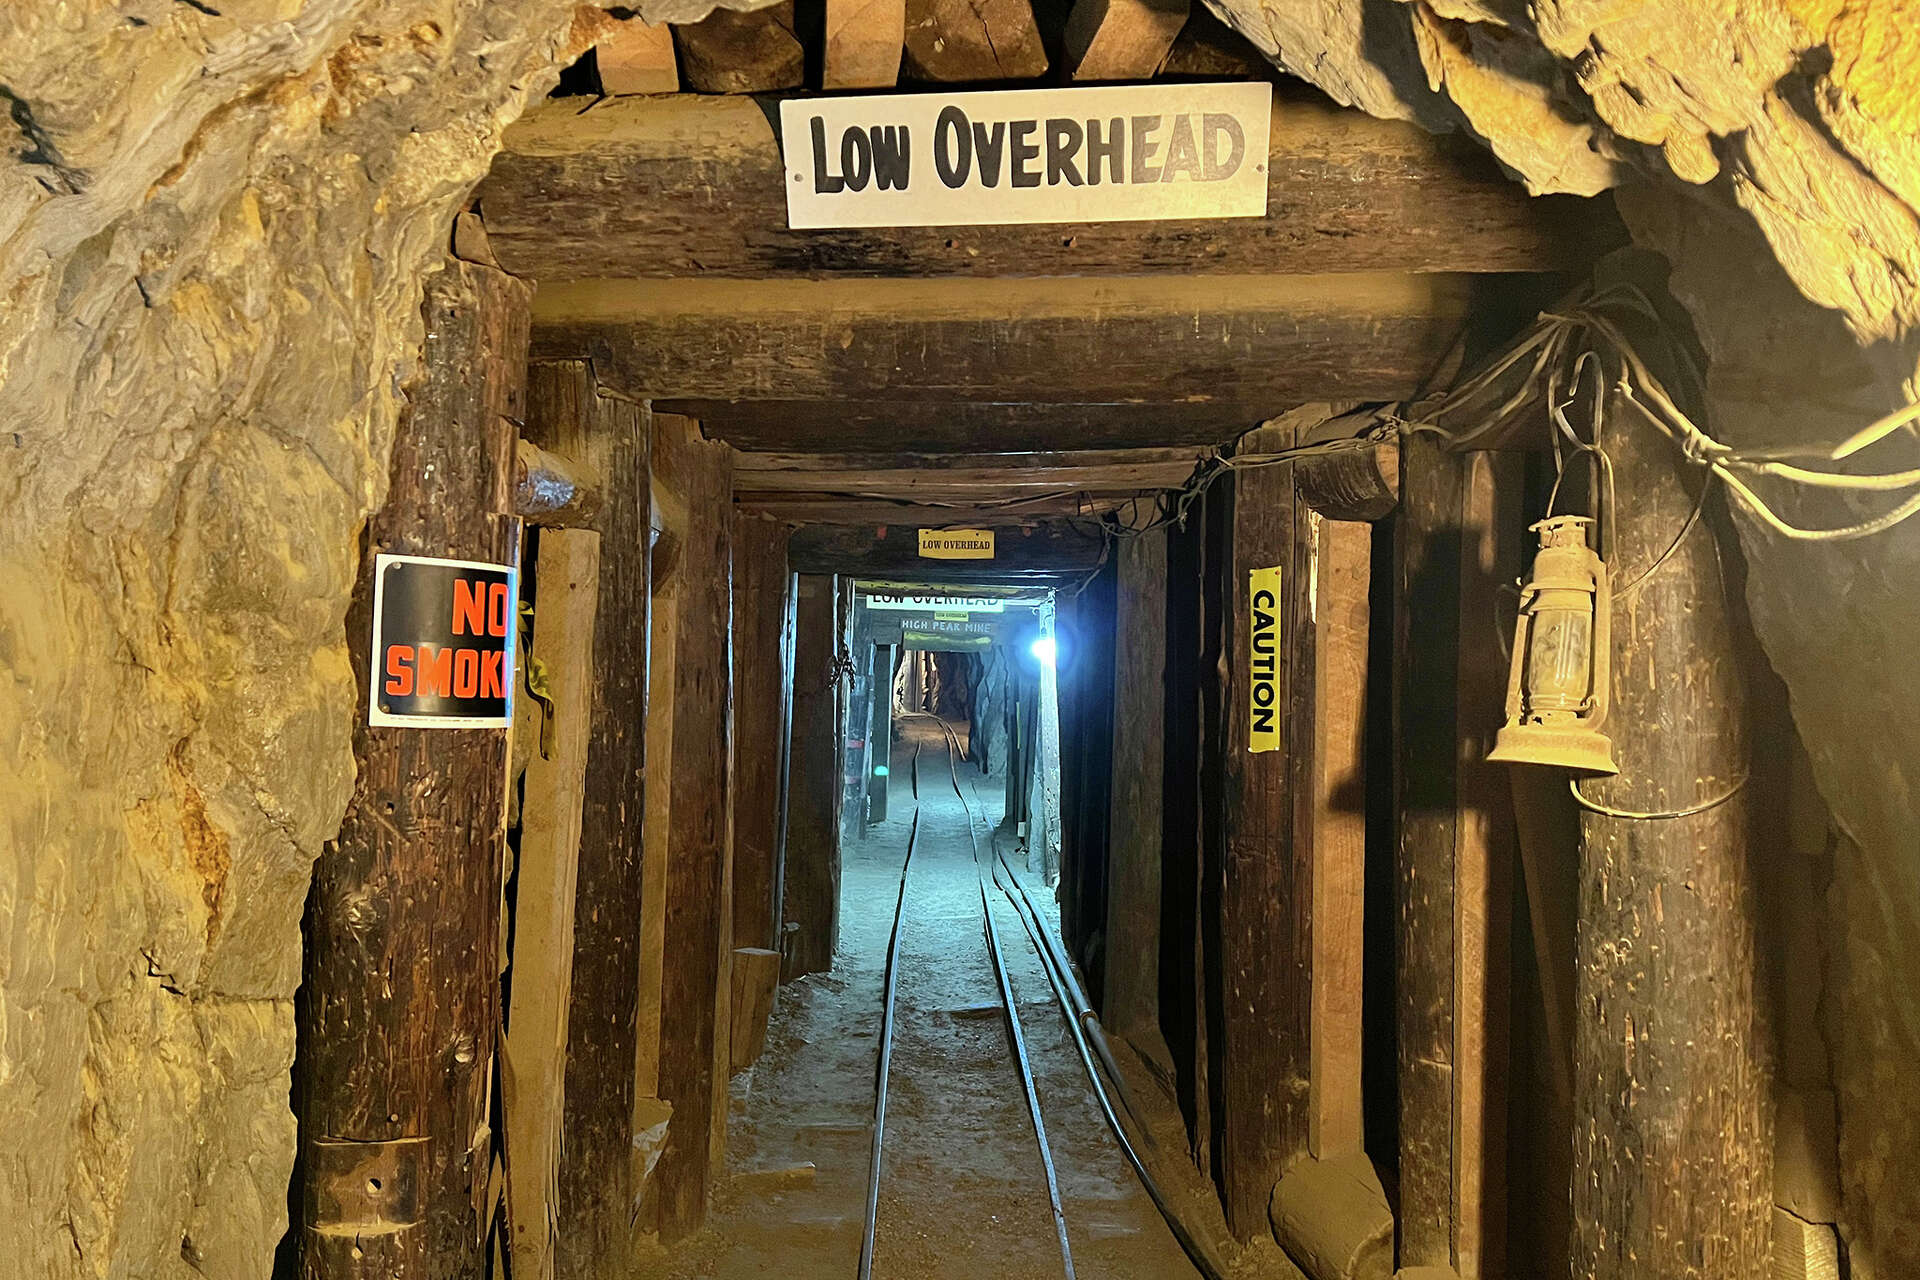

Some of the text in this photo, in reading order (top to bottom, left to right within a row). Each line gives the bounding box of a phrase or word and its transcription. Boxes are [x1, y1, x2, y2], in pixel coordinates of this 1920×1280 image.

[922, 540, 990, 550] LOW OVERHEAD
[452, 578, 509, 637] NO
[902, 620, 991, 633] HIGH PEAK MINE
[1253, 590, 1275, 733] CAUTION
